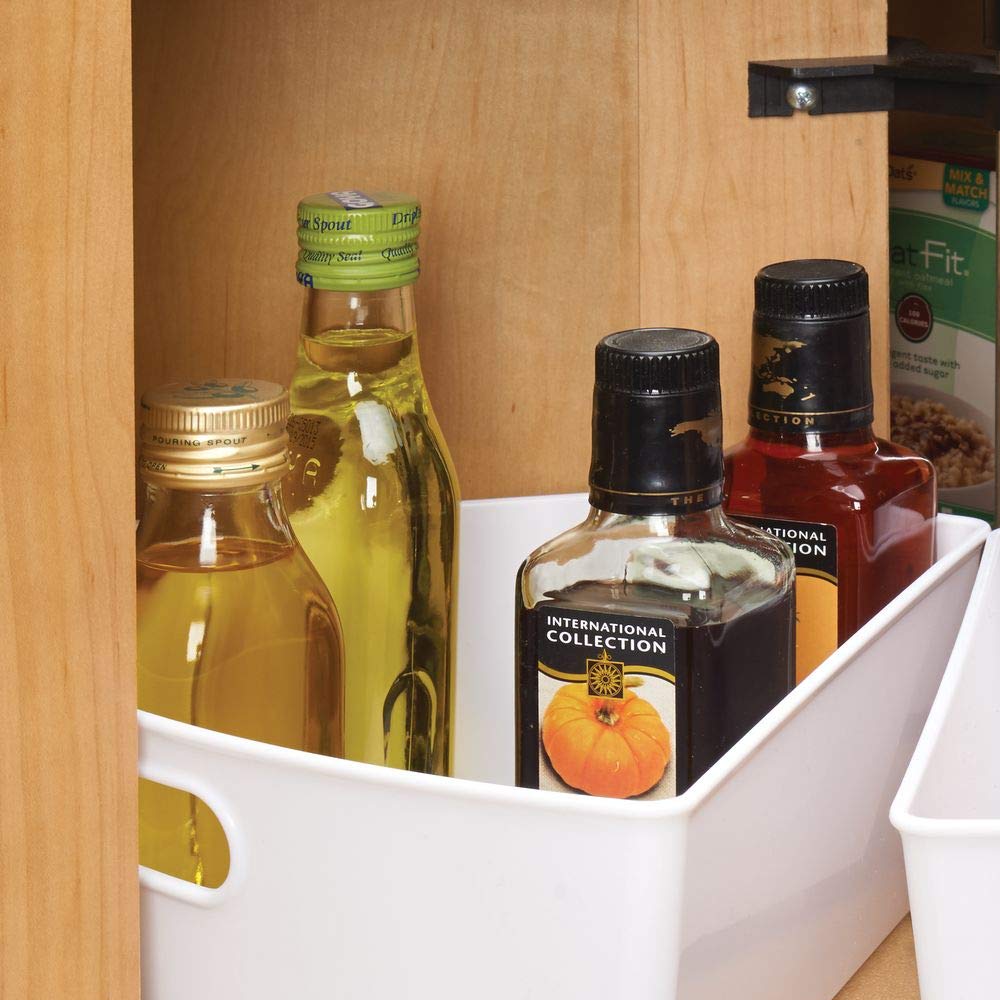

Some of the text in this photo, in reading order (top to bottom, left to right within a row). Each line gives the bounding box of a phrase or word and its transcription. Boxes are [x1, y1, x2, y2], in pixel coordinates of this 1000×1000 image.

[949, 168, 984, 185] MIX &
[945, 183, 988, 199] MATCH
[312, 216, 352, 233] Spout
[152, 435, 248, 447] POURING SPOUT
[671, 492, 704, 506] THE
[547, 615, 667, 639] INTERNATIONAL
[546, 629, 667, 655] COLLECTION
